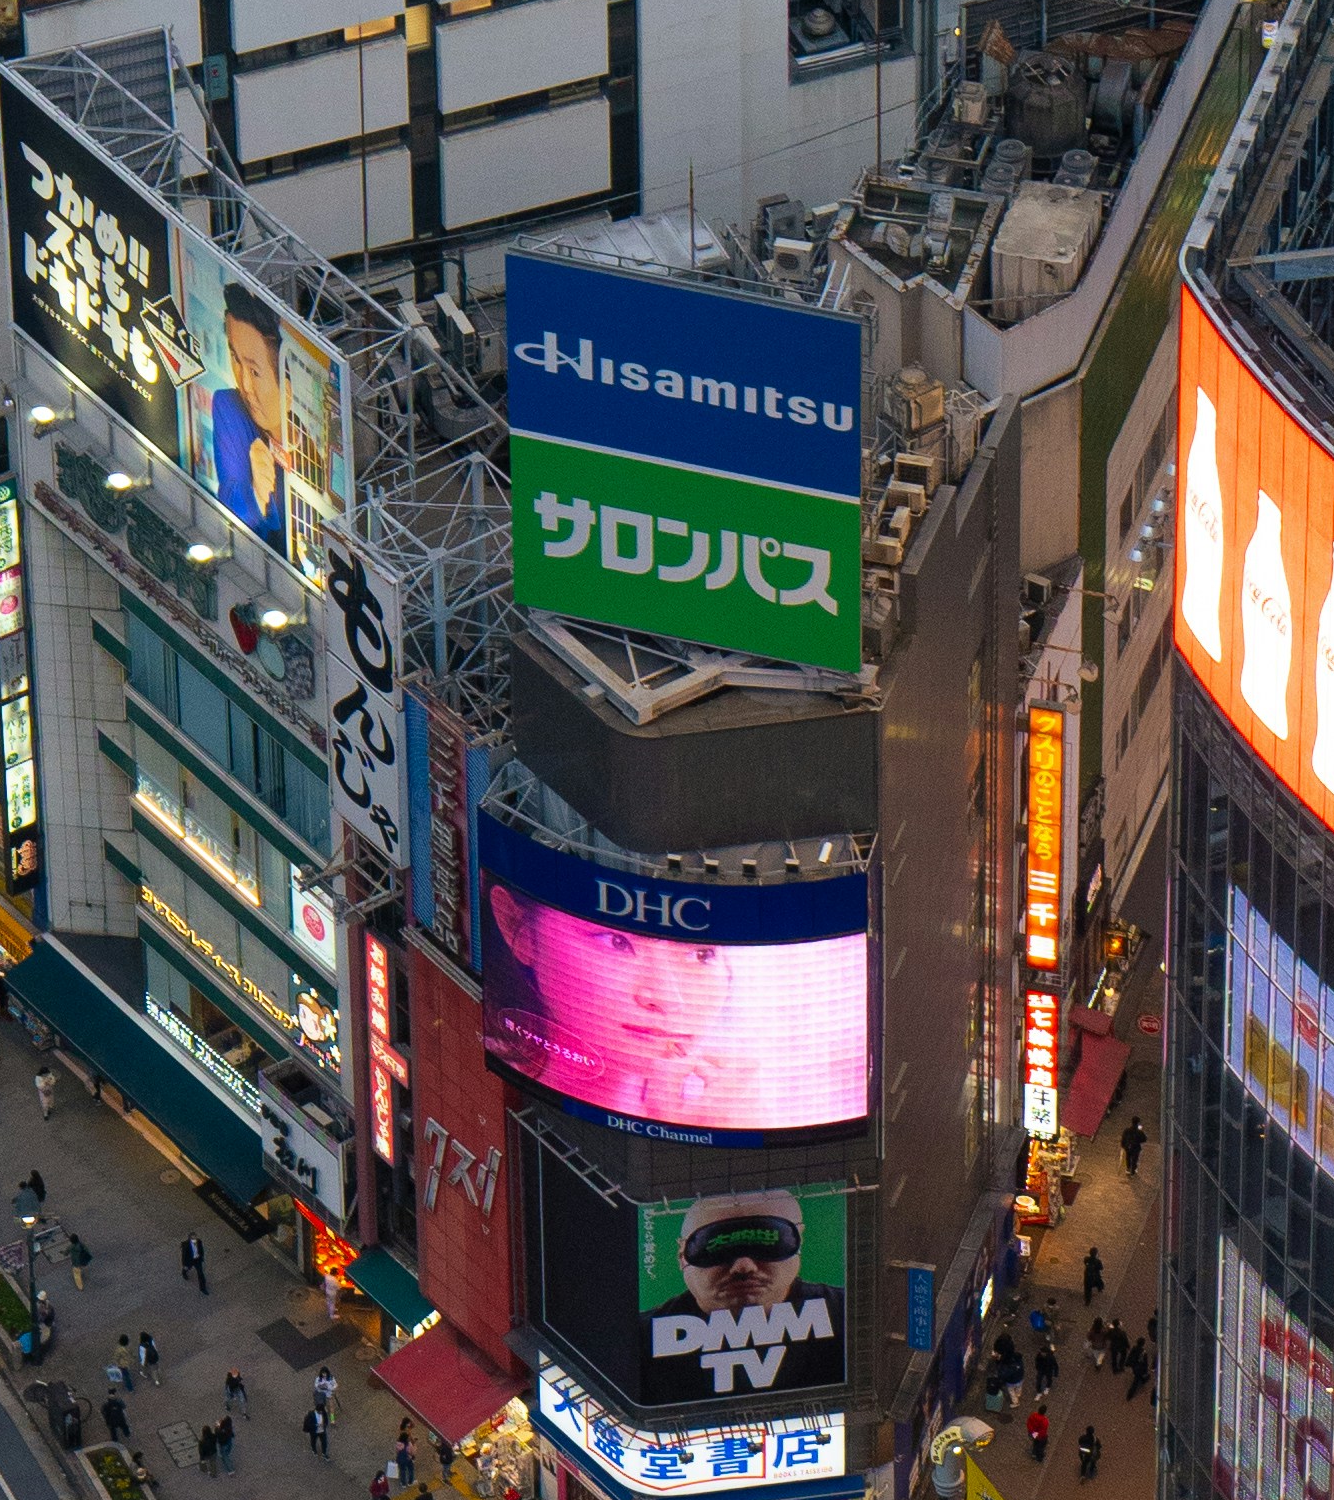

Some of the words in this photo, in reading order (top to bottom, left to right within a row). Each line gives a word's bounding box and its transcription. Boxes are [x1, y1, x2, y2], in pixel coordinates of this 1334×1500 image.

[23, 231, 160, 385] ドキドキも
[43, 209, 132, 314] スキも
[513, 330, 855, 434] Hisamitsu
[532, 490, 839, 617] サロンパス
[328, 546, 400, 855] もんじゃ
[1032, 714, 1058, 863] クスリのことなら
[594, 879, 711, 931] DHC
[1027, 869, 1058, 960] 三千里
[369, 941, 388, 1036] お好み焼
[607, 1113, 643, 1136] DHC
[646, 1124, 714, 1146] Channel
[650, 1297, 836, 1359] DMM
[700, 1345, 788, 1394] TV
[553, 1384, 823, 1481] 大盛堂書店
